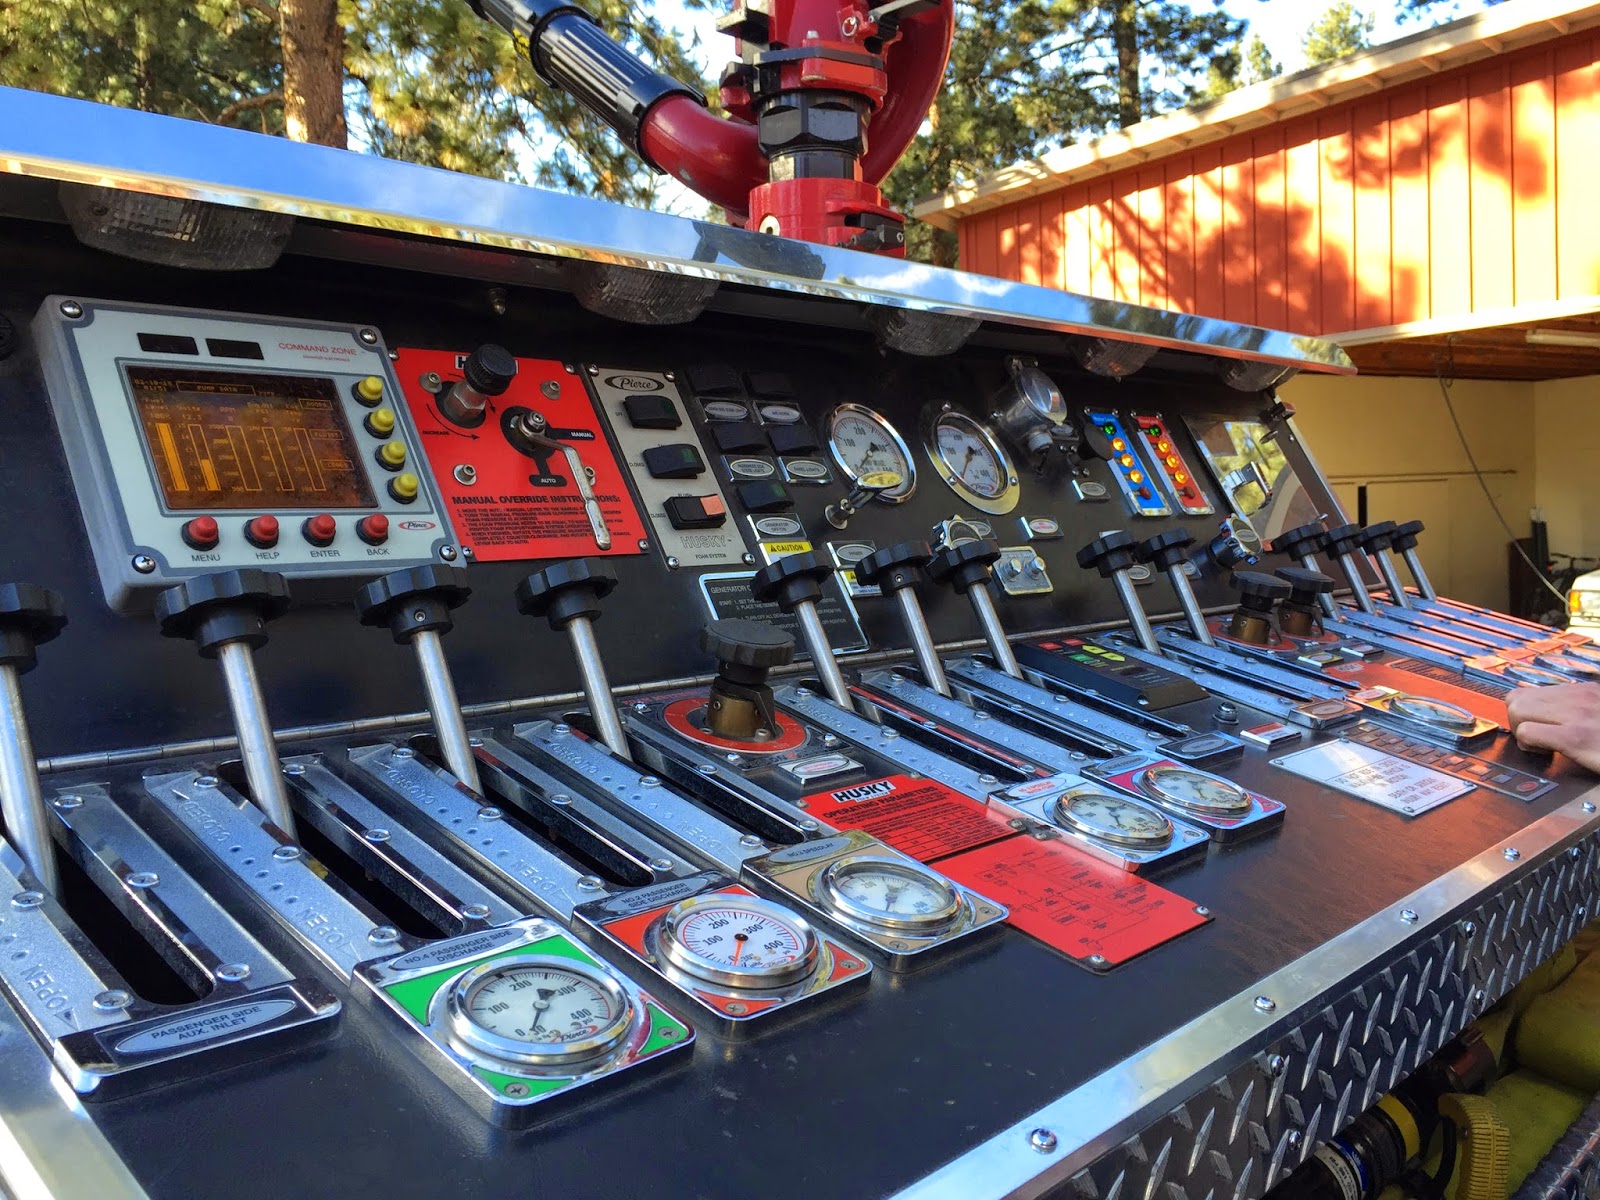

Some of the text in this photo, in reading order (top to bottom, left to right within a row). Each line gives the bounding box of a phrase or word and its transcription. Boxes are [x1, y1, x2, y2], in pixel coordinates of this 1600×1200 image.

[278, 342, 357, 356] COMMAND ZONE
[620, 377, 653, 390] Pierce
[854, 427, 866, 436] 200
[843, 438, 856, 447] 100
[452, 496, 497, 504] MANUAL
[499, 495, 549, 504] OVERRIDE
[680, 535, 726, 548] HUSKY
[191, 554, 221, 562] MENU
[255, 552, 280, 560] HELP
[310, 550, 341, 558] ENTER
[367, 548, 390, 556] BACK
[711, 585, 747, 594] GENERATOR
[833, 781, 893, 802] HUSKY
[822, 800, 880, 819] OPERATING
[878, 786, 938, 804] PARAMETERS
[510, 858, 557, 892] OPEN
[641, 882, 688, 899] PASSENGER
[628, 886, 693, 908] SIDE DISCHARGE
[294, 906, 345, 944] OPEN
[708, 918, 730, 930] 200
[742, 923, 763, 935] 300
[702, 934, 724, 946] 100
[763, 939, 784, 951] 400
[404, 929, 513, 964] NO.4 PASSENGER SIDE
[436, 941, 495, 963] DISCHARGE
[20, 963, 69, 1010] OPEN
[508, 979, 533, 991] 200
[555, 985, 577, 996] 300
[488, 1001, 510, 1014] 100
[570, 1007, 592, 1020] 400
[151, 1006, 262, 1039] PASSENGER SIDE
[582, 1017, 594, 1025] psi
[178, 1017, 247, 1040] AUX. INLET
[515, 1028, 526, 1037] 0
